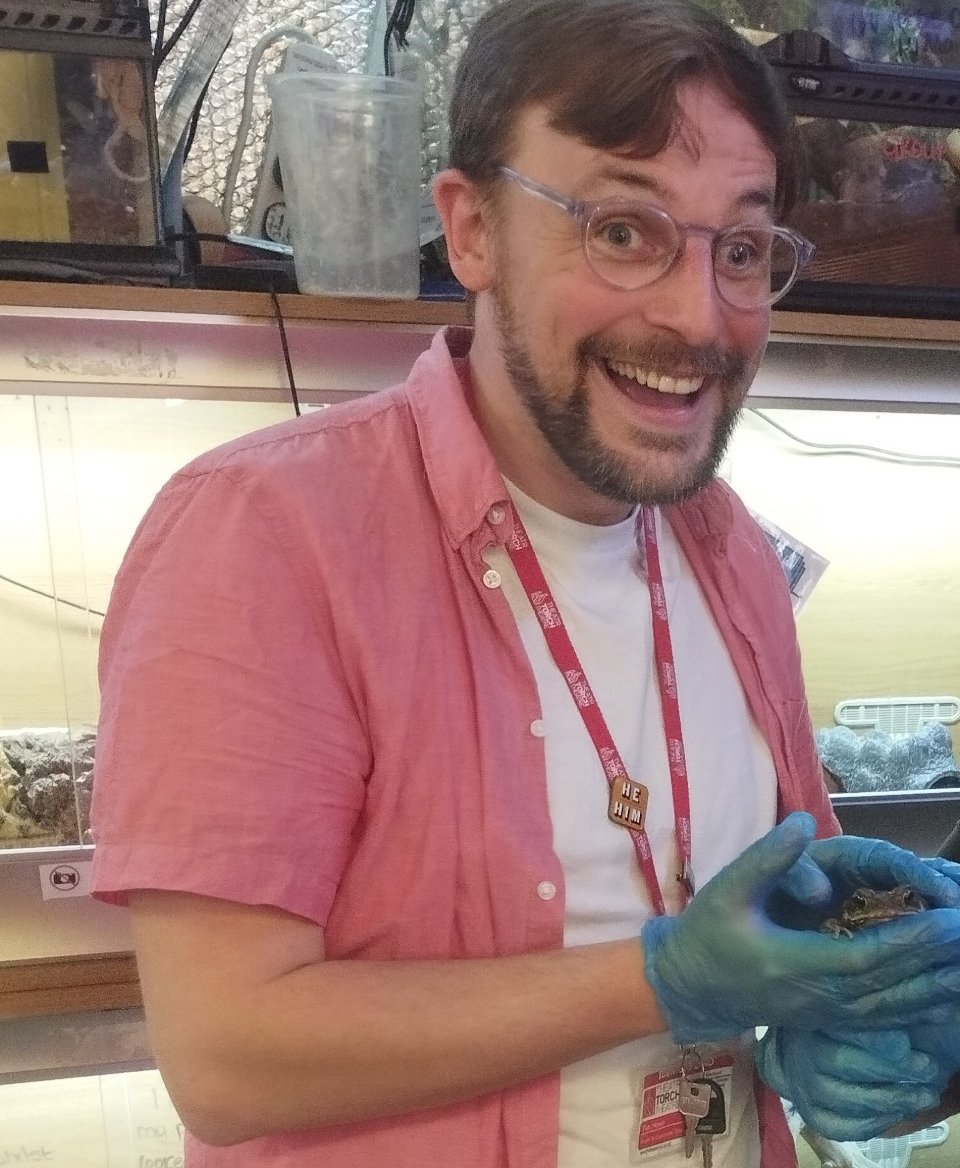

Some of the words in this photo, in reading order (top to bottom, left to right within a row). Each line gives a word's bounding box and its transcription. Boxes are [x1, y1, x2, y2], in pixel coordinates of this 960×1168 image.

[541, 603, 556, 629] TORCH
[575, 682, 590, 707] TORCH
[622, 782, 641, 804] HE
[614, 801, 642, 825] HIM
[656, 1089, 680, 1105] TORCH
